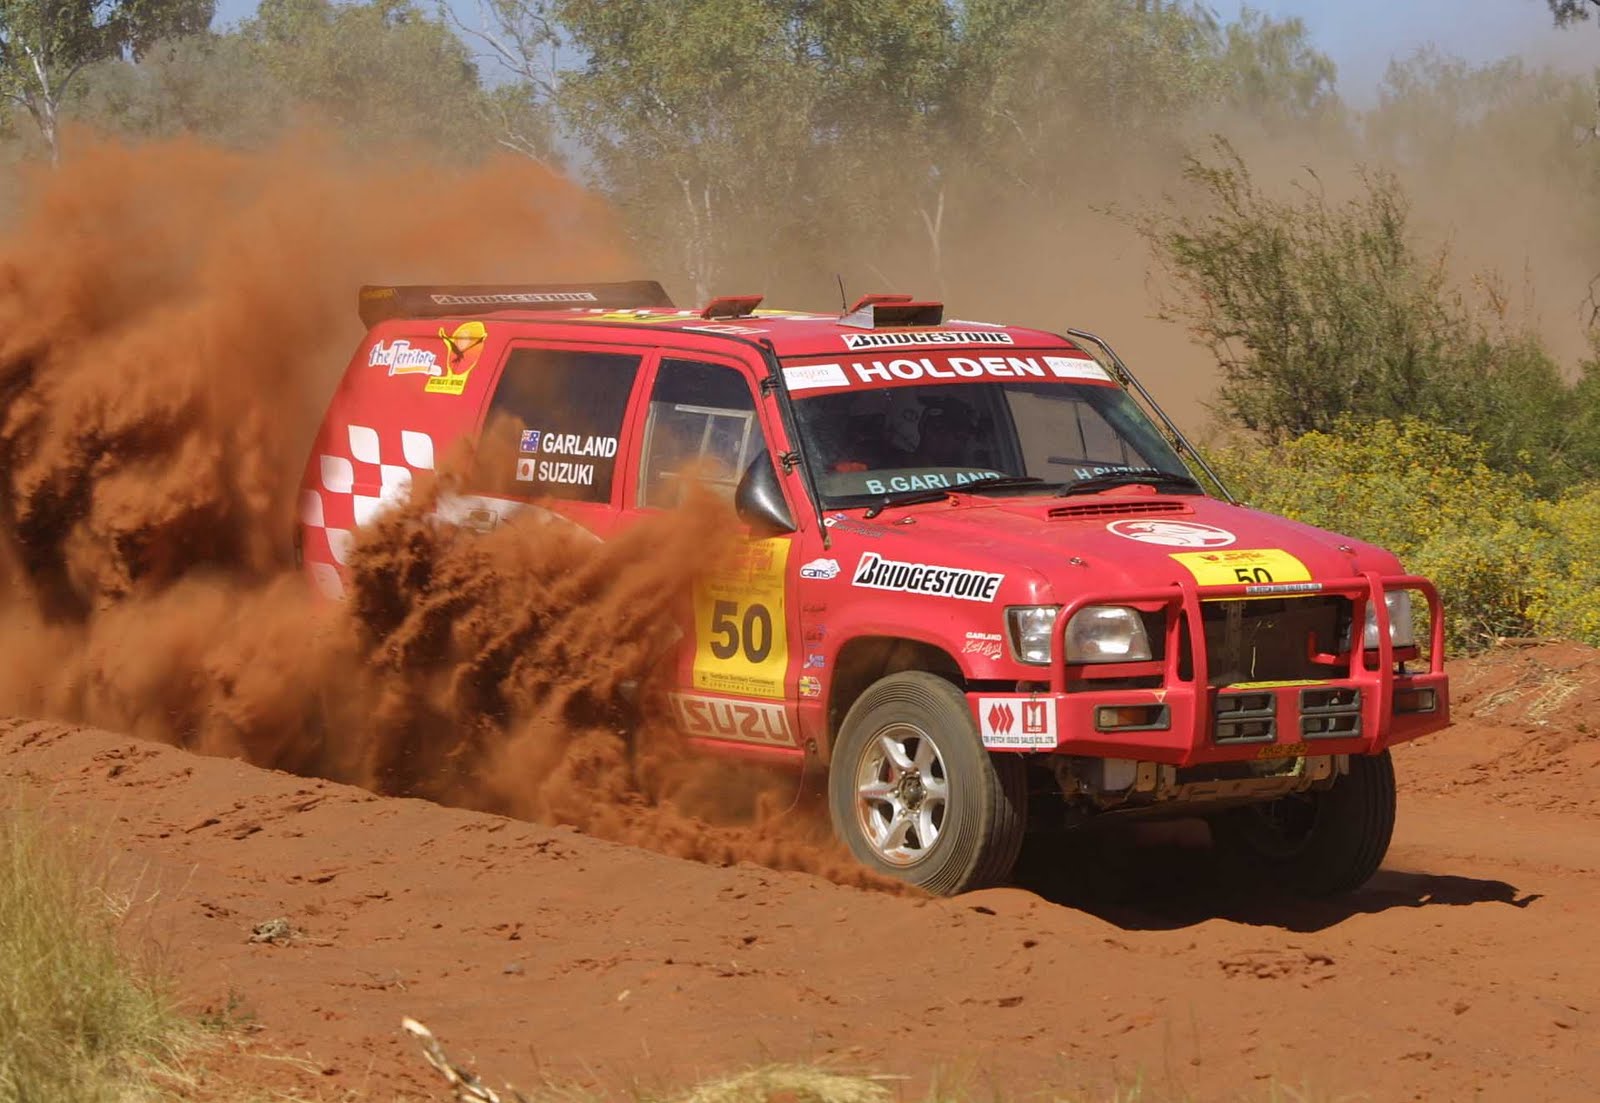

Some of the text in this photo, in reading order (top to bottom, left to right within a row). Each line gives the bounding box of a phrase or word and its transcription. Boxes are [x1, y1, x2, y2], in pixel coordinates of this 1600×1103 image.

[851, 332, 1011, 348] BRIDGESTONE
[370, 341, 435, 374] the Territory
[852, 357, 1047, 383] HOLDEN
[542, 432, 618, 458] GARLAND
[537, 461, 594, 485] SUZUKI
[801, 568, 830, 578] cams
[855, 555, 1000, 600] BRIDGESTONE
[1234, 567, 1274, 583] 50
[710, 601, 773, 664] 50
[965, 632, 1002, 641] GARLAND
[670, 697, 790, 740] ISUZU
